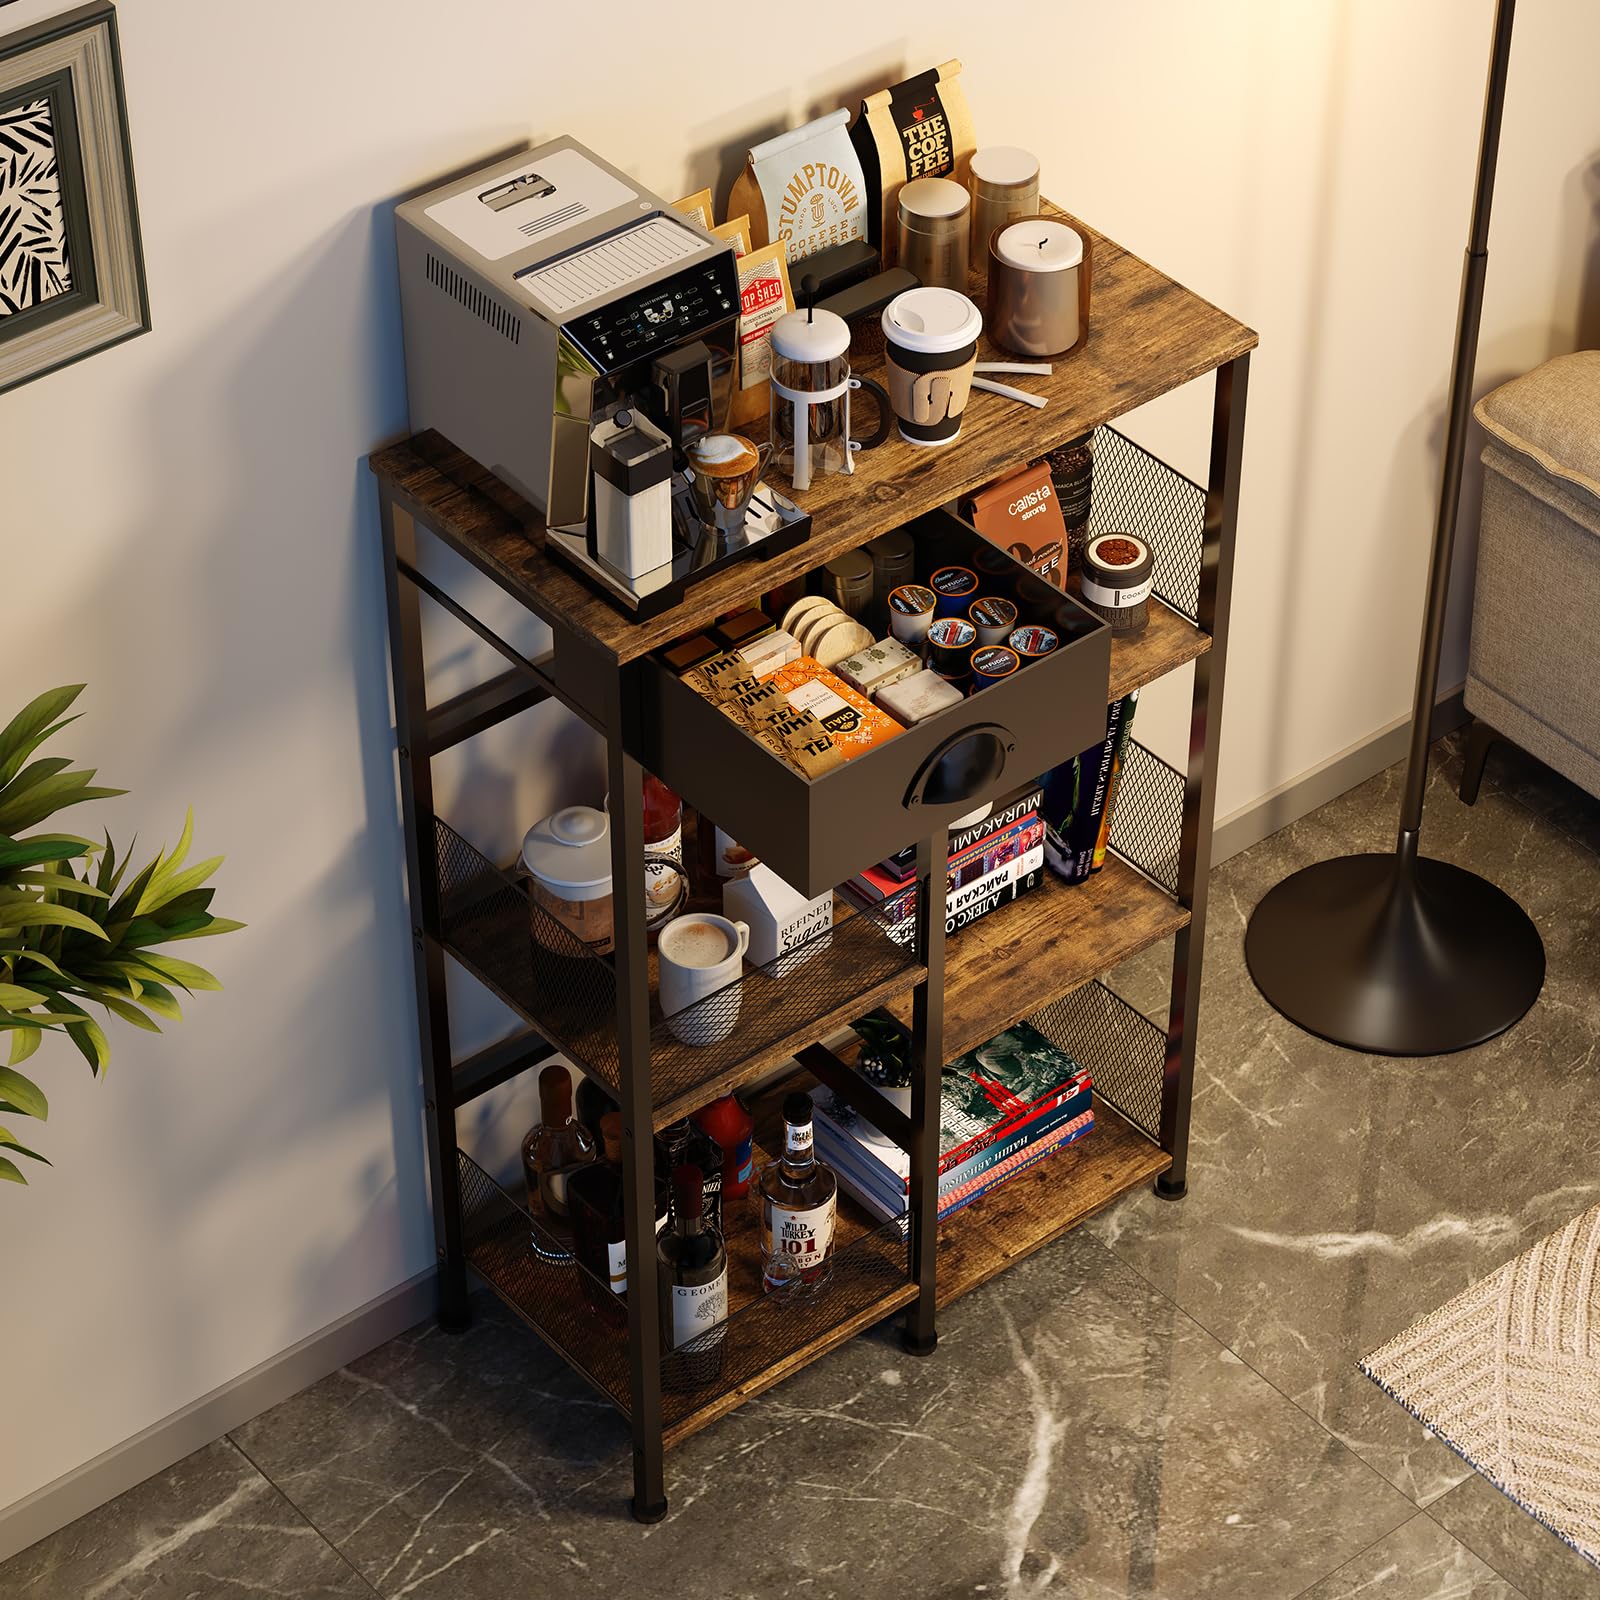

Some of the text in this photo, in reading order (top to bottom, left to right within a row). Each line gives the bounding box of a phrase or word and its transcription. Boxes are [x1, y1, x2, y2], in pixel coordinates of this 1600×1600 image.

[902, 115, 946, 145] THE
[908, 131, 947, 161] COF
[910, 146, 950, 178] FEE
[778, 162, 859, 241] STUMPTOWN
[785, 226, 858, 263] OASTERS
[788, 219, 848, 253] COFFEE
[757, 281, 781, 303] SHED
[1021, 502, 1047, 521] strong
[824, 710, 857, 731] CHALI
[953, 793, 1041, 852] MURAKAMI
[956, 870, 1009, 909] РАЙСКАЯ
[780, 900, 832, 939] REFINED
[957, 891, 1002, 928] АЛЕКС
[780, 915, 830, 956] Sugar
[994, 1135, 1029, 1162] НАШИ
[702, 1179, 722, 1194] NIEL'S
[780, 1227, 816, 1240] TURKEY
[784, 1221, 808, 1232] WILD
[780, 1237, 818, 1255] 101
